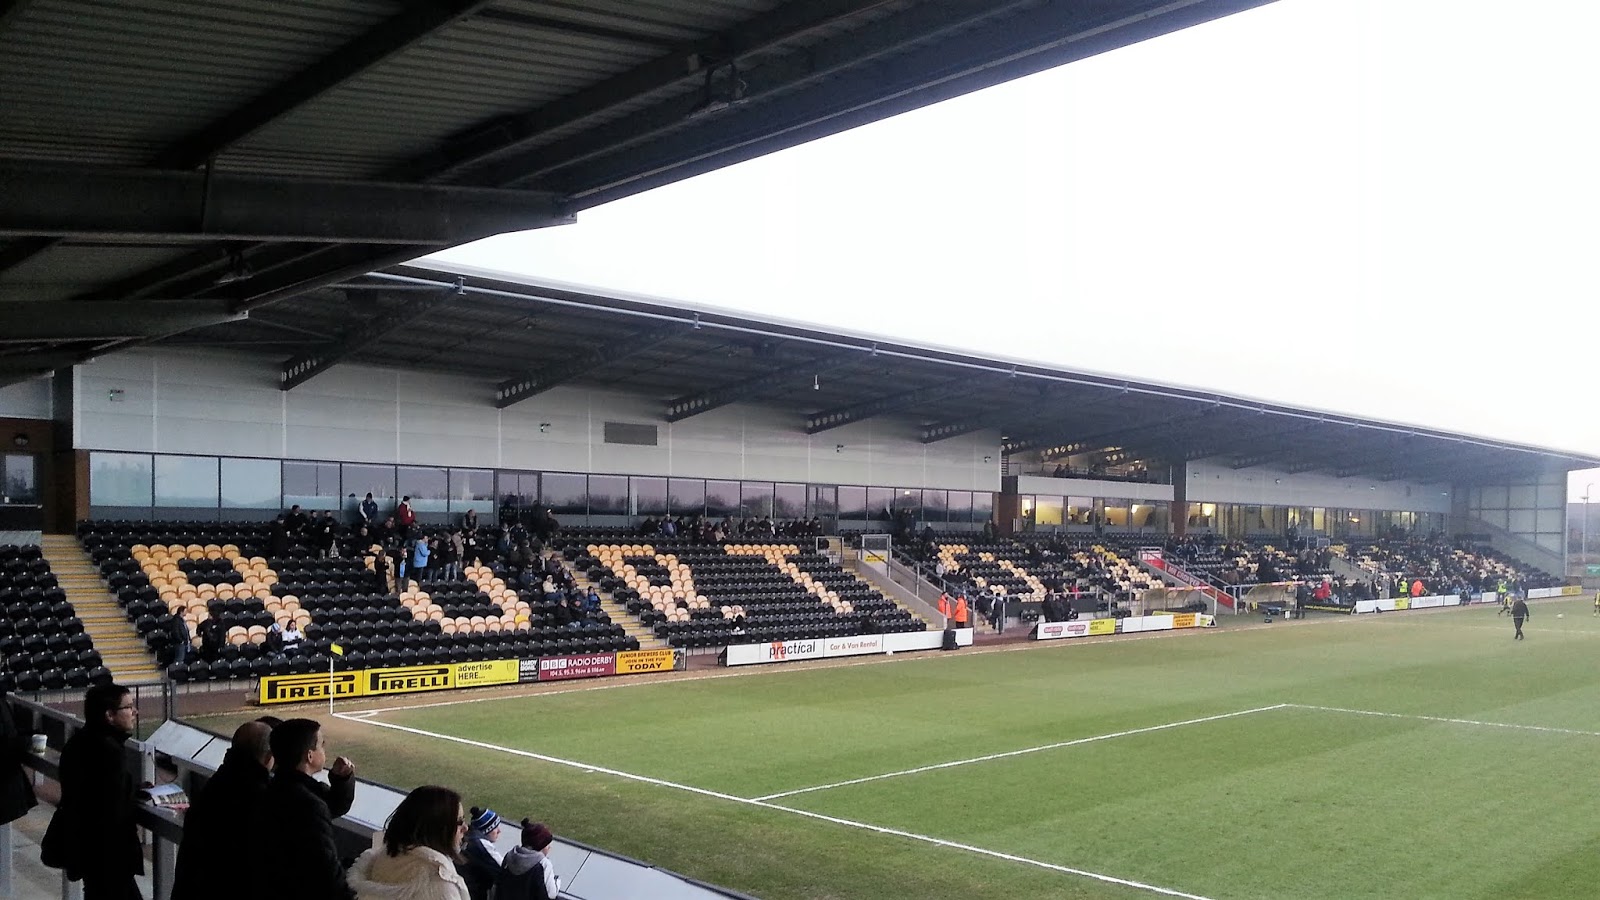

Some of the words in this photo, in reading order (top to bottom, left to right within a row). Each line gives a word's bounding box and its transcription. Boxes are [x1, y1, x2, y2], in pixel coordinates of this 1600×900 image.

[770, 642, 816, 658] practical
[458, 663, 492, 672] advertise
[541, 658, 567, 670] BBC
[568, 658, 590, 666] RADIO
[592, 656, 613, 664] DERBY
[628, 662, 662, 670] TODAY
[370, 668, 450, 690] PIRELLI
[268, 674, 355, 700] PIRELLI
